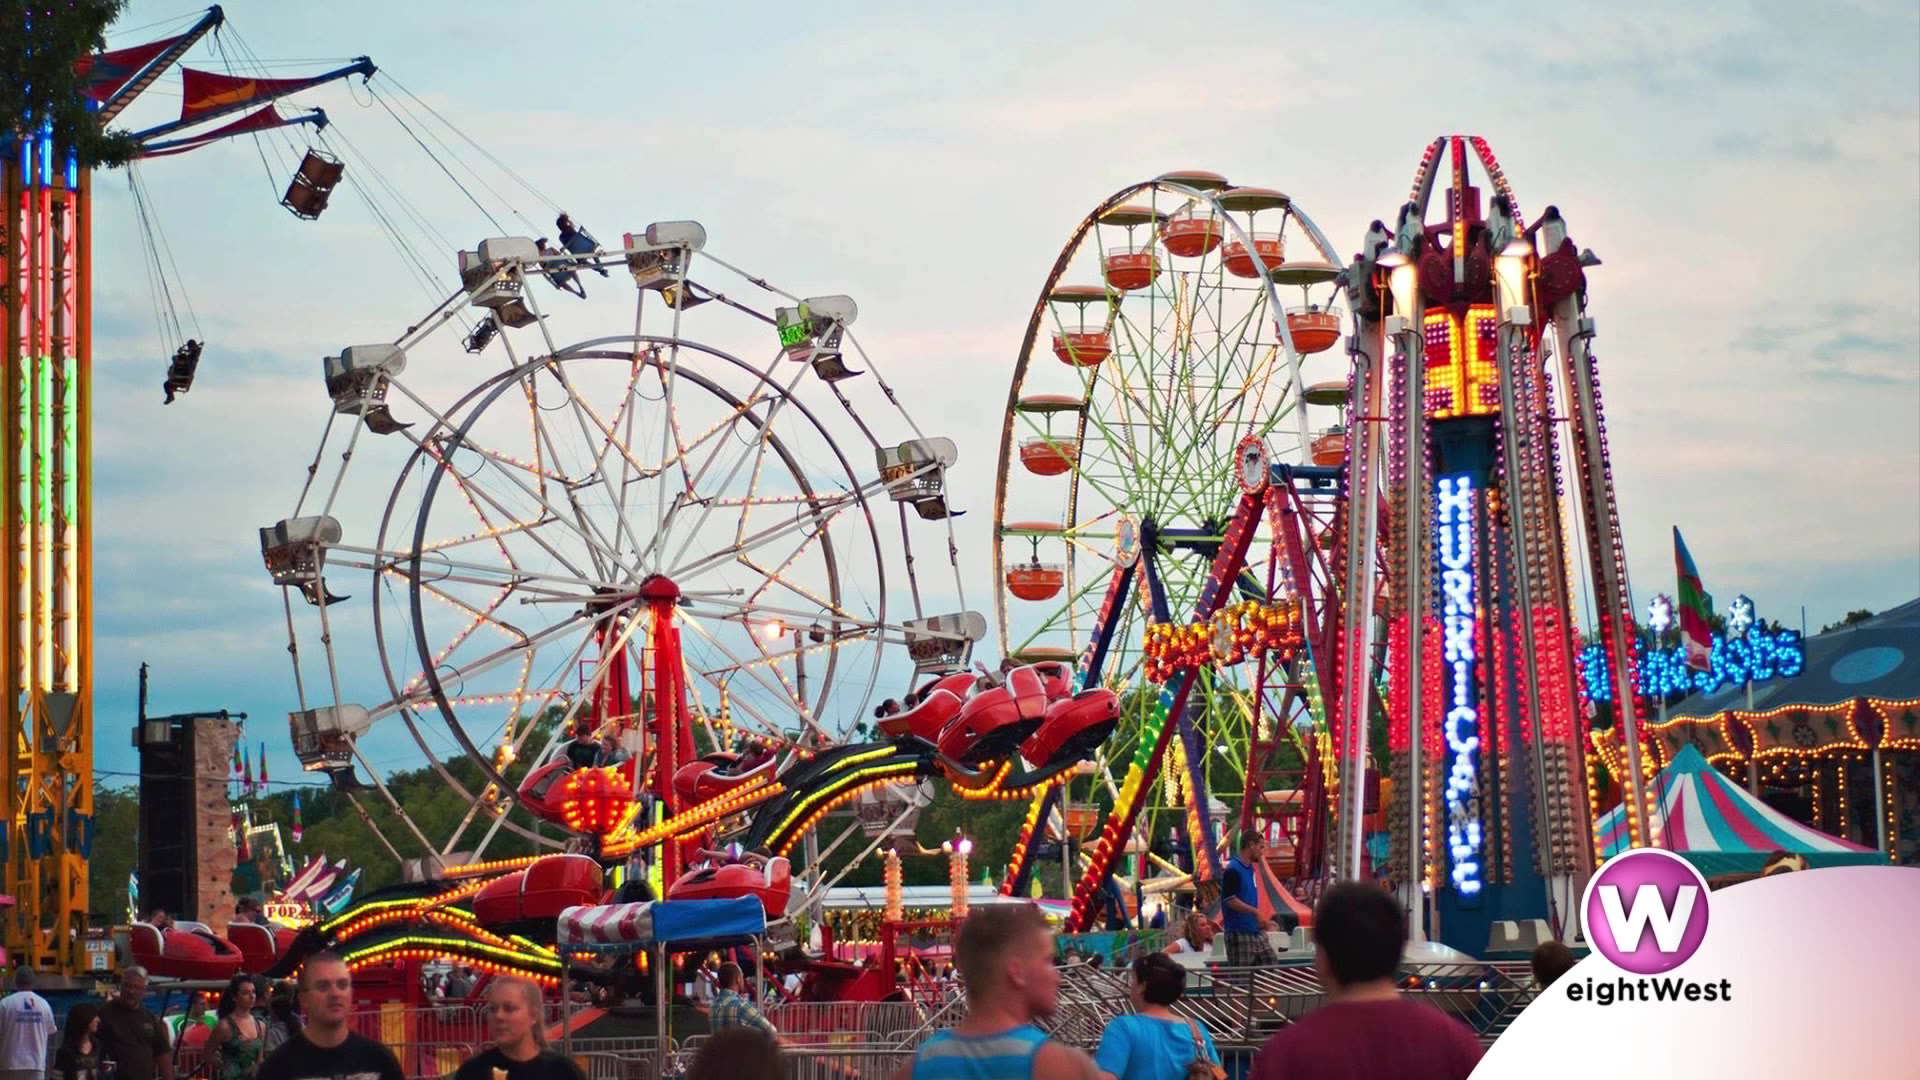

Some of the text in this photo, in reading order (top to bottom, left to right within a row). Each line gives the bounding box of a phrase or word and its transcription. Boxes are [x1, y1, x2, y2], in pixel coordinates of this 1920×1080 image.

[1262, 243, 1272, 252] 10
[1320, 317, 1328, 326] 11
[1438, 477, 1481, 893] HURRICANE
